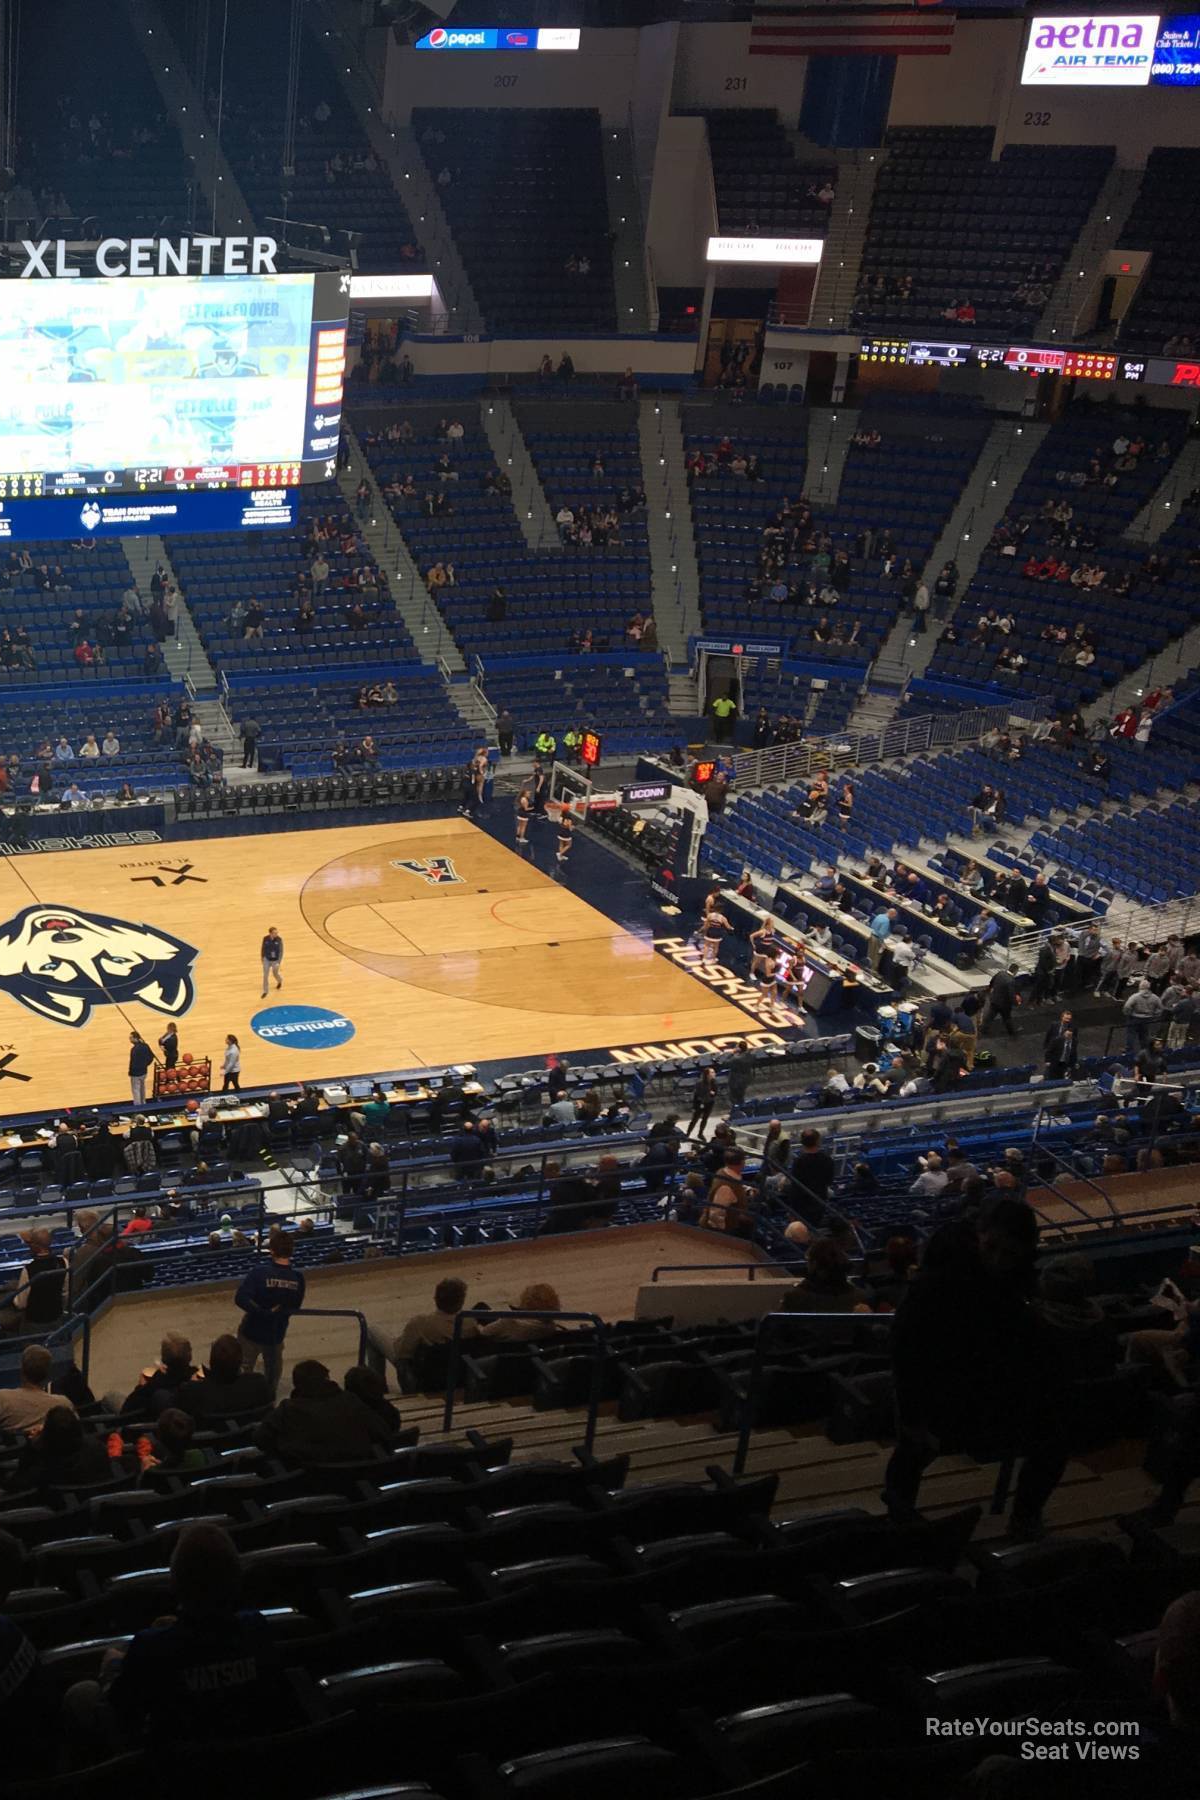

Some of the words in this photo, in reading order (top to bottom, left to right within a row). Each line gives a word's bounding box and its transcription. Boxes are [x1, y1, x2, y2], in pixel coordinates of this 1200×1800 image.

[448, 32, 485, 47] pepsi
[1035, 19, 1143, 48] aetna
[1156, 39, 1171, 48] Club
[1053, 55, 1087, 65] AIR
[1092, 55, 1148, 65] TEMP
[493, 75, 519, 88] 207
[725, 77, 748, 91] 231
[1023, 112, 1052, 126] 232
[20, 239, 80, 278] XL
[95, 237, 278, 277] CENTER
[249, 301, 280, 317] OVER
[948, 348, 958, 358] 0
[978, 350, 1003, 361] 12:21
[1018, 352, 1028, 362] 0
[774, 361, 793, 370] 107
[1124, 363, 1144, 372] 6:41
[1125, 372, 1140, 380] PM
[104, 471, 115, 484] 0
[135, 469, 162, 483] 12:21
[174, 468, 184, 481] 0
[103, 507, 126, 516] TEAM
[629, 788, 665, 800] UCONN
[652, 937, 805, 1028] HUSKIES
[258, 1018, 350, 1037] genius3D
